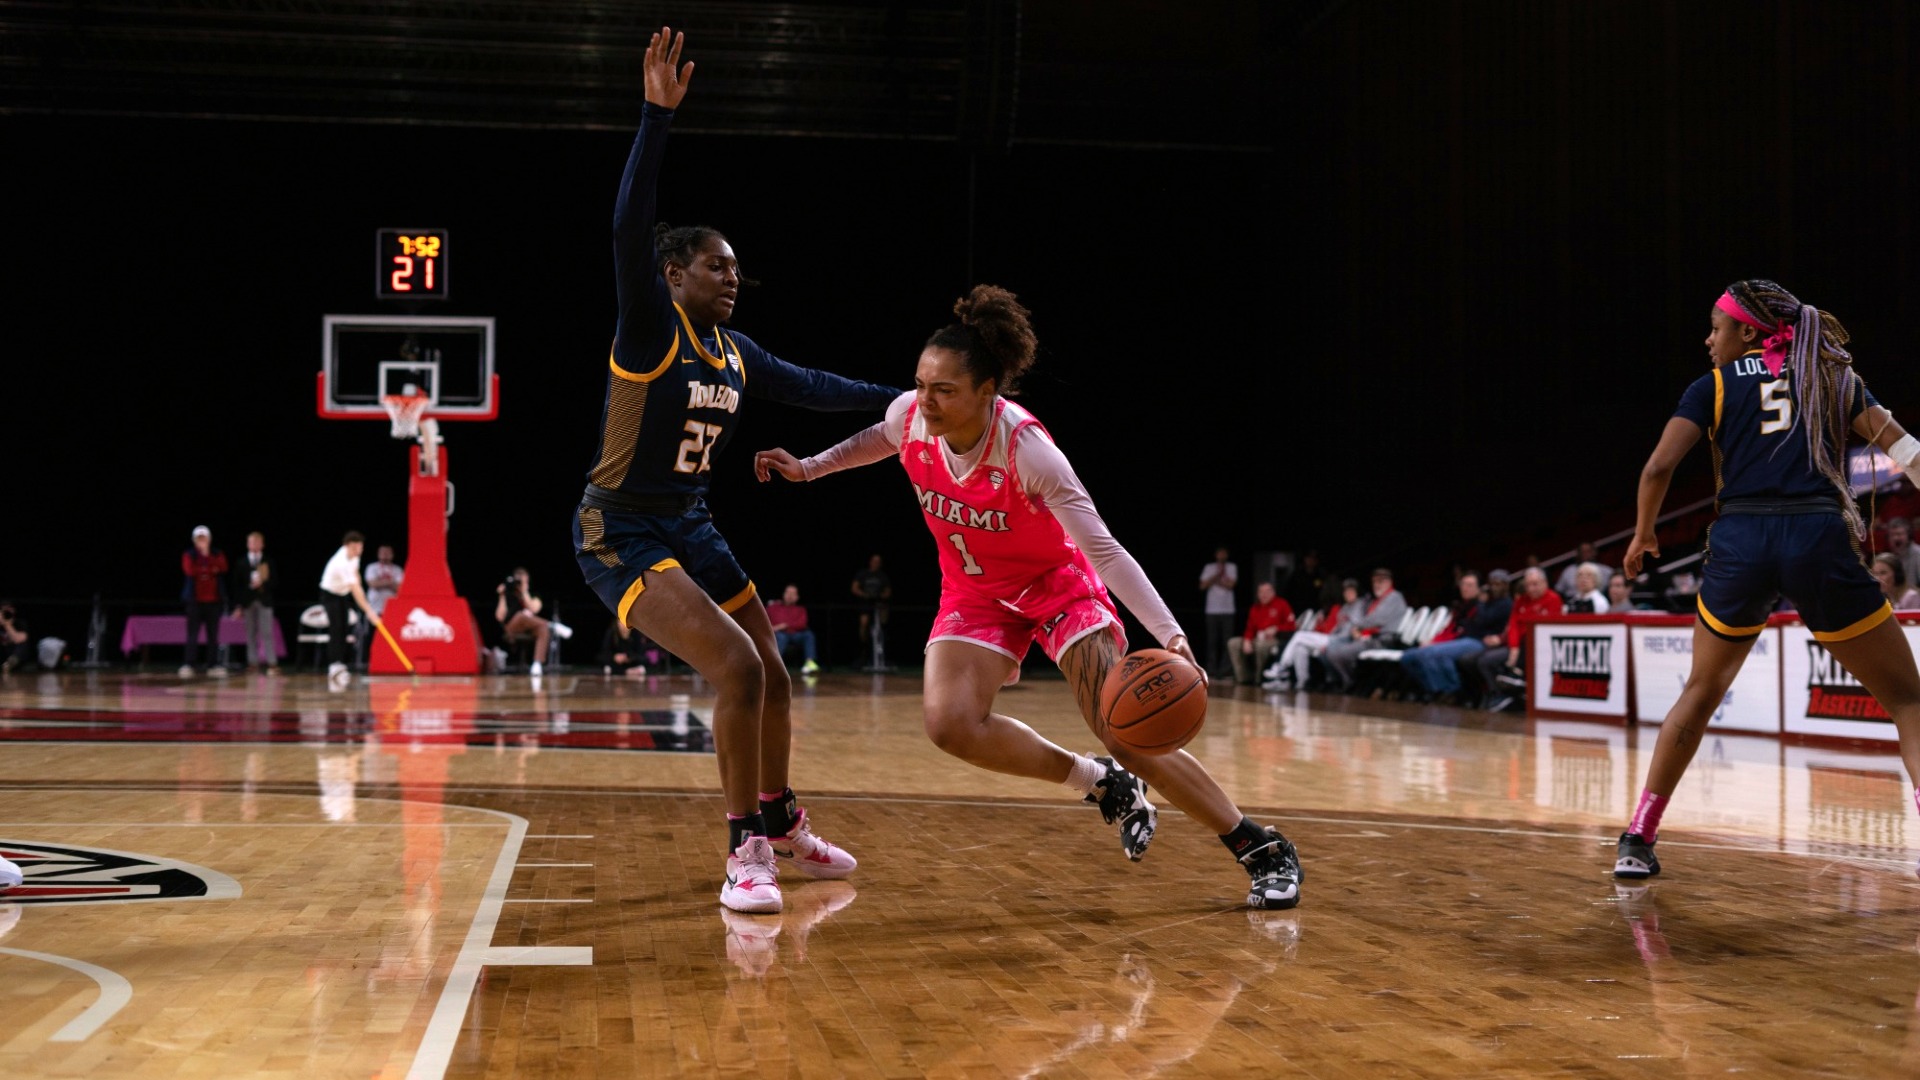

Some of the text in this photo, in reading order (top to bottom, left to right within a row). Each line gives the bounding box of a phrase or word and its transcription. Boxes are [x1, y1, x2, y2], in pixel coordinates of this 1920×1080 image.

[398, 235, 441, 257] 7:52
[392, 255, 435, 291] 21
[687, 380, 739, 414] TOLEDO
[1760, 379, 1792, 435] 5
[912, 482, 1012, 532] MIAMI
[947, 532, 985, 576] 1
[1552, 638, 1611, 673] MIAMI
[1133, 669, 1175, 702] PRO
